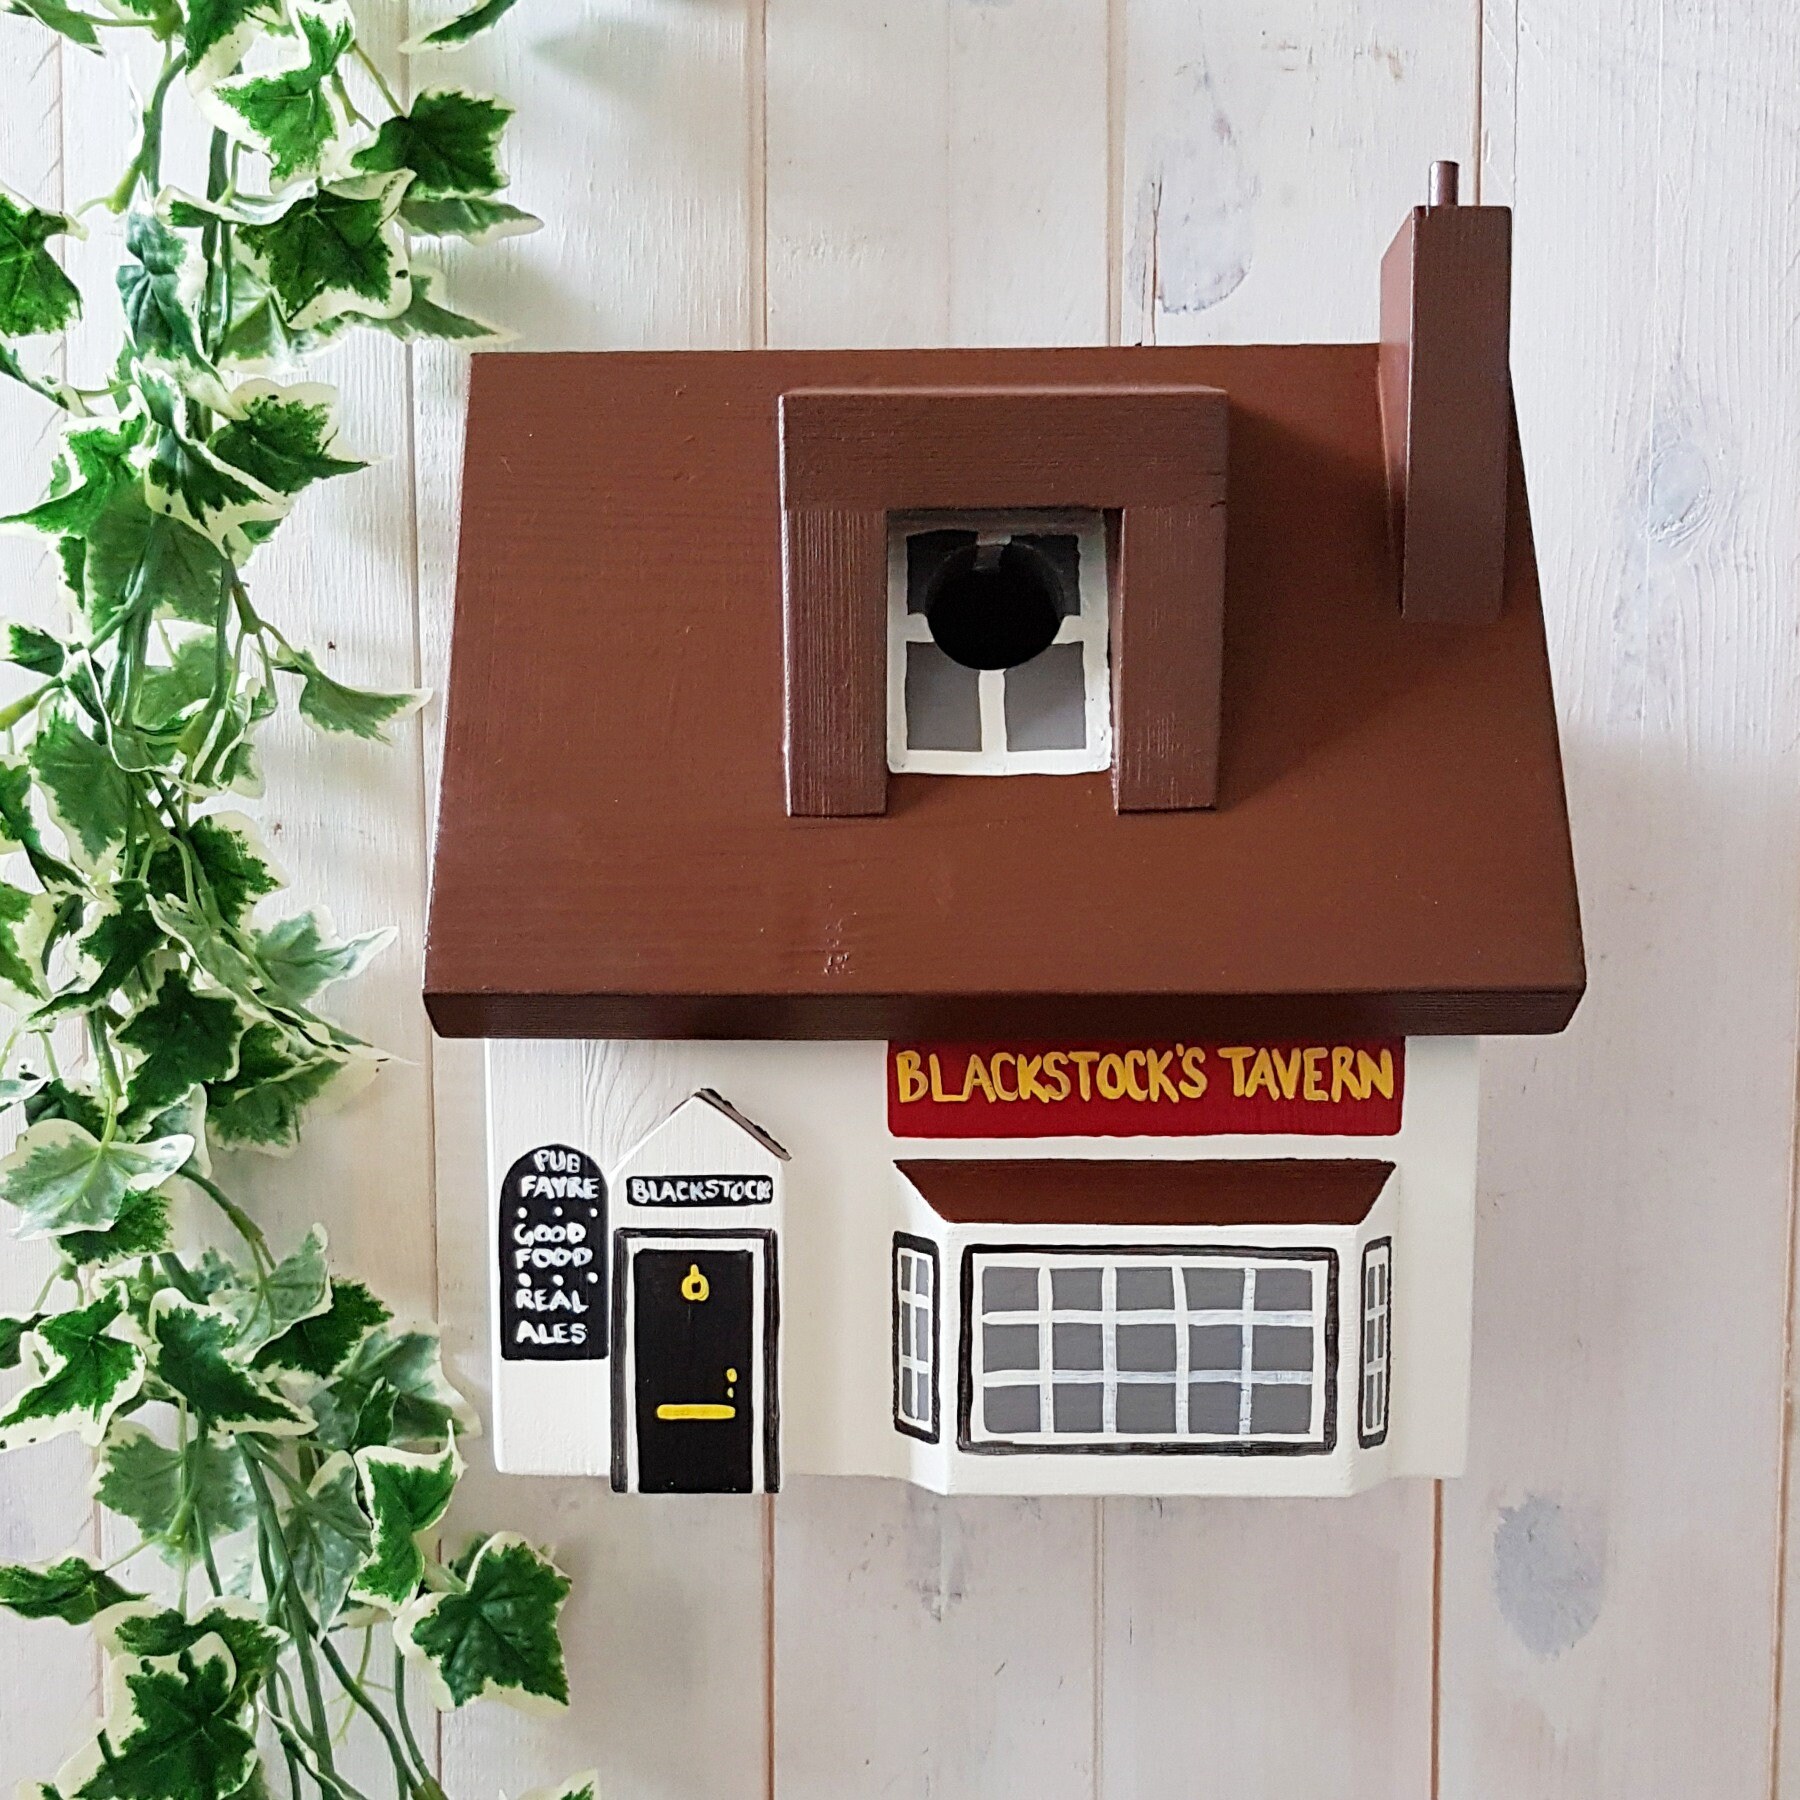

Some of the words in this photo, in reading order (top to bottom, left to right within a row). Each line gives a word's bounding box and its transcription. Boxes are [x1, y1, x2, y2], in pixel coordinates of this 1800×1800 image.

[896, 1043, 1208, 1103] BLACKSTOCK'S
[1217, 1046, 1394, 1103] TAVERN
[533, 1149, 581, 1173] PUB
[520, 1175, 599, 1199] FAYRE
[631, 1178, 772, 1204] BLACKSTOCK
[514, 1222, 586, 1247] GOOD
[514, 1247, 593, 1269] FOOD
[515, 1289, 589, 1313] REAL
[516, 1320, 588, 1344] ALES
